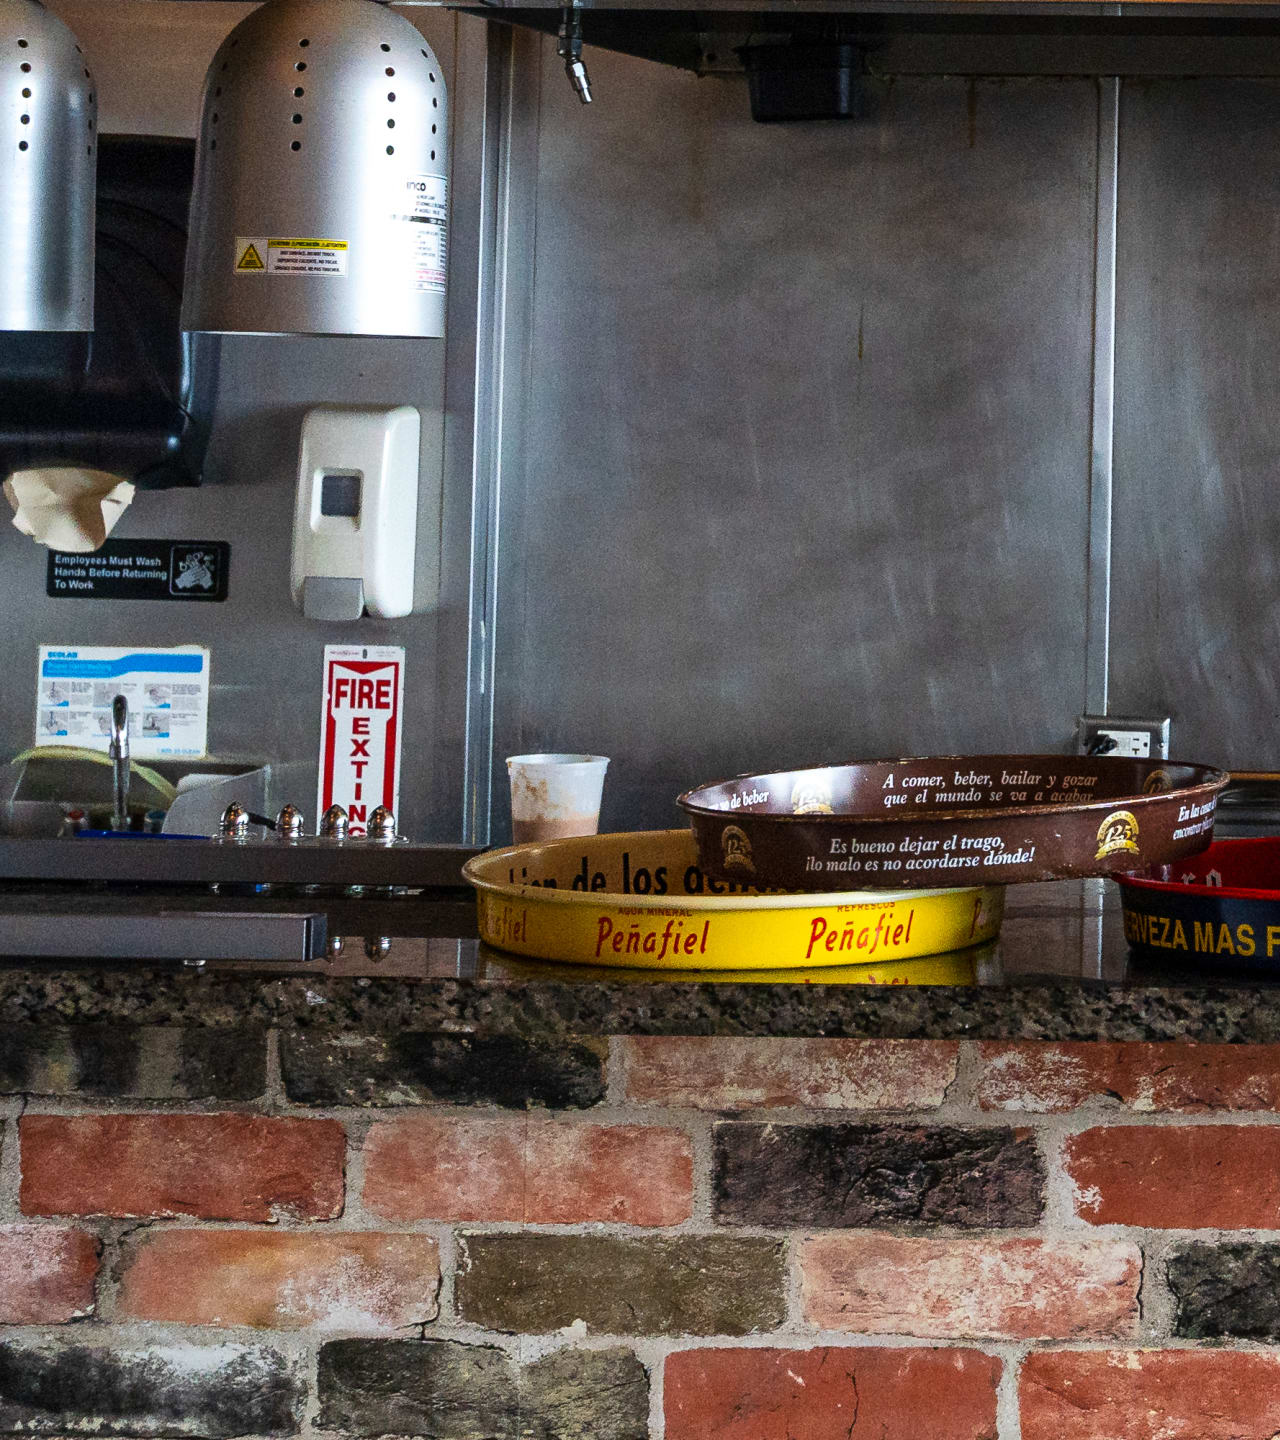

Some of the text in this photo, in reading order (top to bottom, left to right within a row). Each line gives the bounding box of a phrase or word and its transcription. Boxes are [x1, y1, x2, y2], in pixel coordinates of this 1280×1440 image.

[55, 555, 161, 566] Employees Must Wash
[55, 568, 167, 580] Hands Before Returning
[55, 579, 93, 589] To Work
[335, 679, 391, 709] FIRE
[882, 771, 1097, 788] A comer, beber, bailar y gozar
[743, 789, 769, 807] beber
[884, 794, 907, 808] que
[915, 790, 927, 803] el
[936, 788, 981, 803] mundo
[990, 790, 1002, 800] se
[1011, 791, 1026, 801] va
[1034, 791, 1043, 801] a
[830, 835, 1005, 855] Es bueno dejar el trago,
[1104, 825, 1132, 846] 125
[826, 857, 860, 871] malo
[865, 860, 879, 871] es
[883, 859, 901, 871] no
[906, 854, 979, 870] acordarse
[984, 848, 1035, 865] dónde!
[623, 852, 668, 896] los
[647, 908, 692, 917] MINERAL
[596, 917, 710, 960] Peñafiel
[806, 910, 914, 959] Peñafiel
[1194, 921, 1254, 956] MAS
